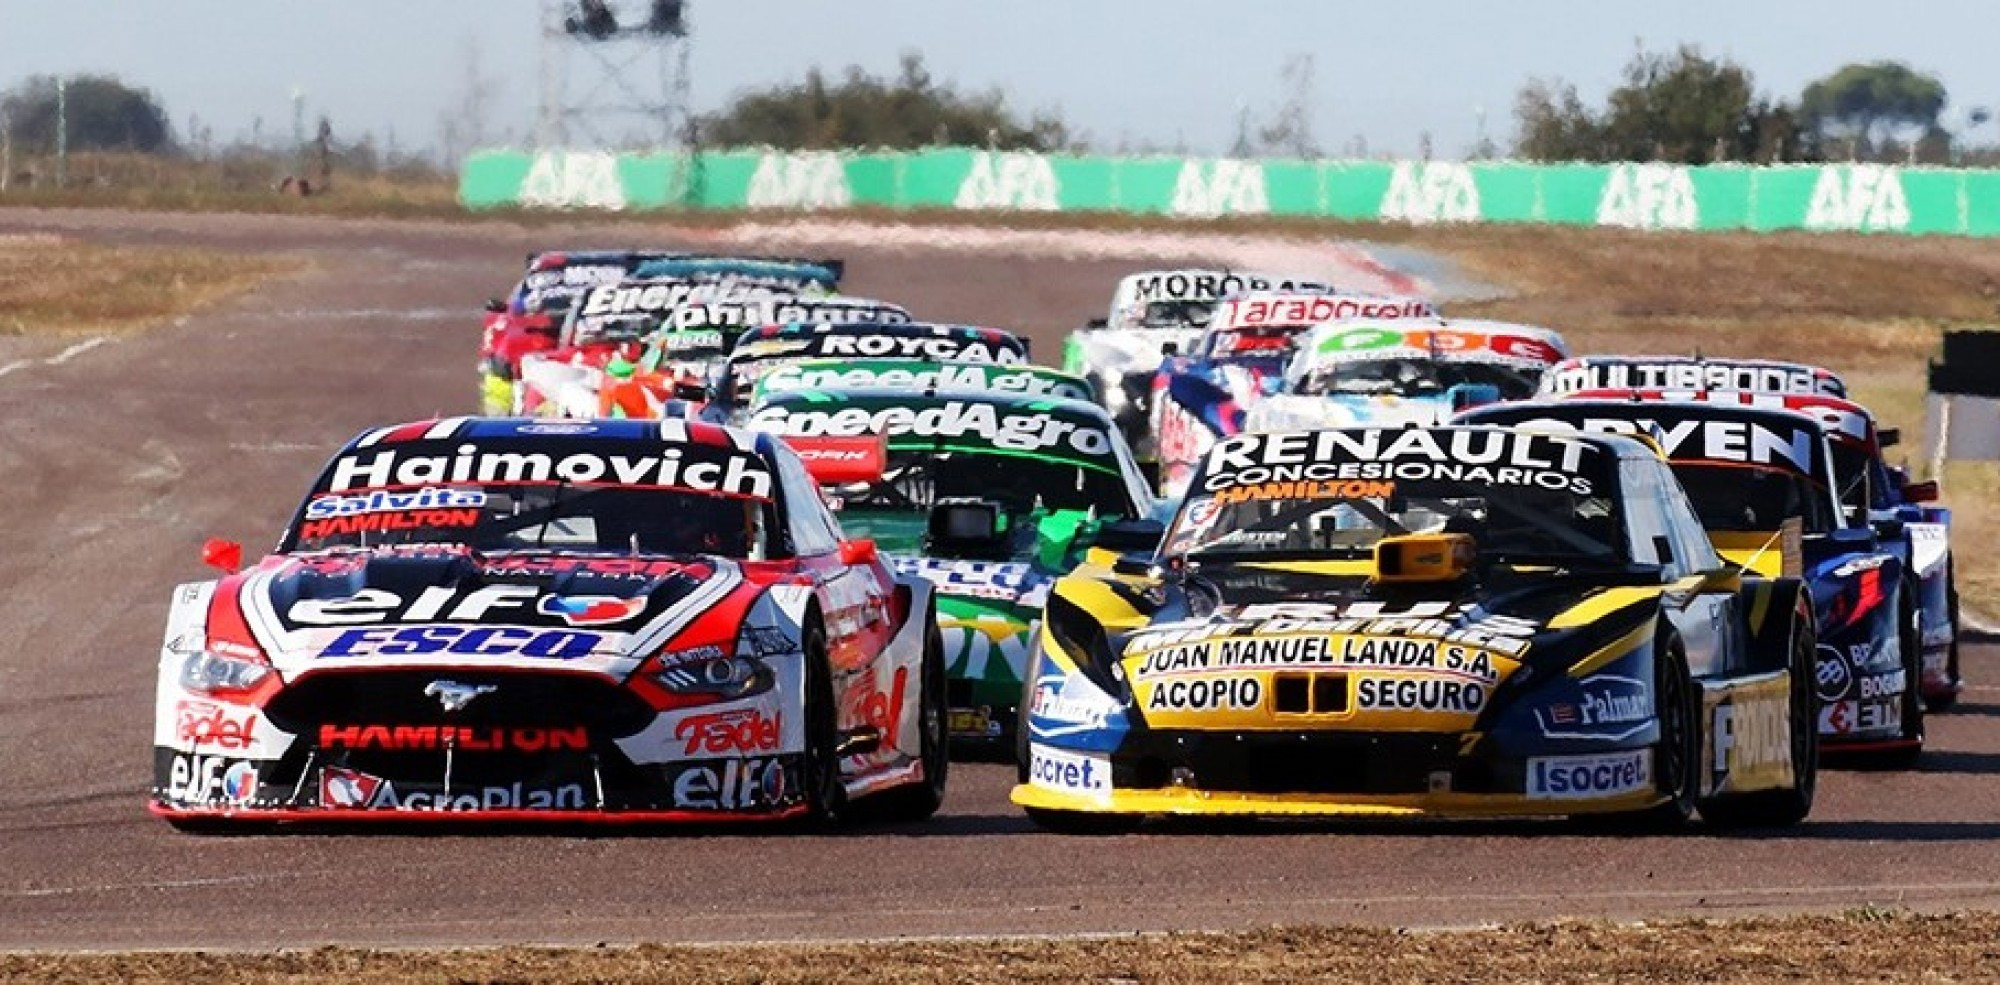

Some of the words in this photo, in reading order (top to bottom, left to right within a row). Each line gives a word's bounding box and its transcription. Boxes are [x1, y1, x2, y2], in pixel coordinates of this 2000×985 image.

[746, 401, 1113, 455] SpeedAgro
[1206, 428, 1598, 476] RENAULT
[331, 445, 772, 498] Haimovich
[1204, 463, 1594, 496] CONCESIONARIOS
[307, 488, 486, 517] Salvita
[1214, 479, 1396, 504] HAMILTON
[301, 509, 480, 539] HAMILTON
[288, 585, 539, 623] elf
[316, 626, 603, 660] ESCO
[1139, 643, 1209, 674] JUAN
[1218, 638, 1334, 666] MANUEL
[1343, 639, 1436, 667] LANDA
[1445, 646, 1498, 679] S.A.
[1149, 679, 1261, 709] ACOPIO
[1357, 678, 1485, 711] SEGURO
[319, 725, 589, 750] HAMILTON
[675, 707, 782, 756] Fadel
[170, 755, 224, 801] elf
[673, 758, 763, 809] elf
